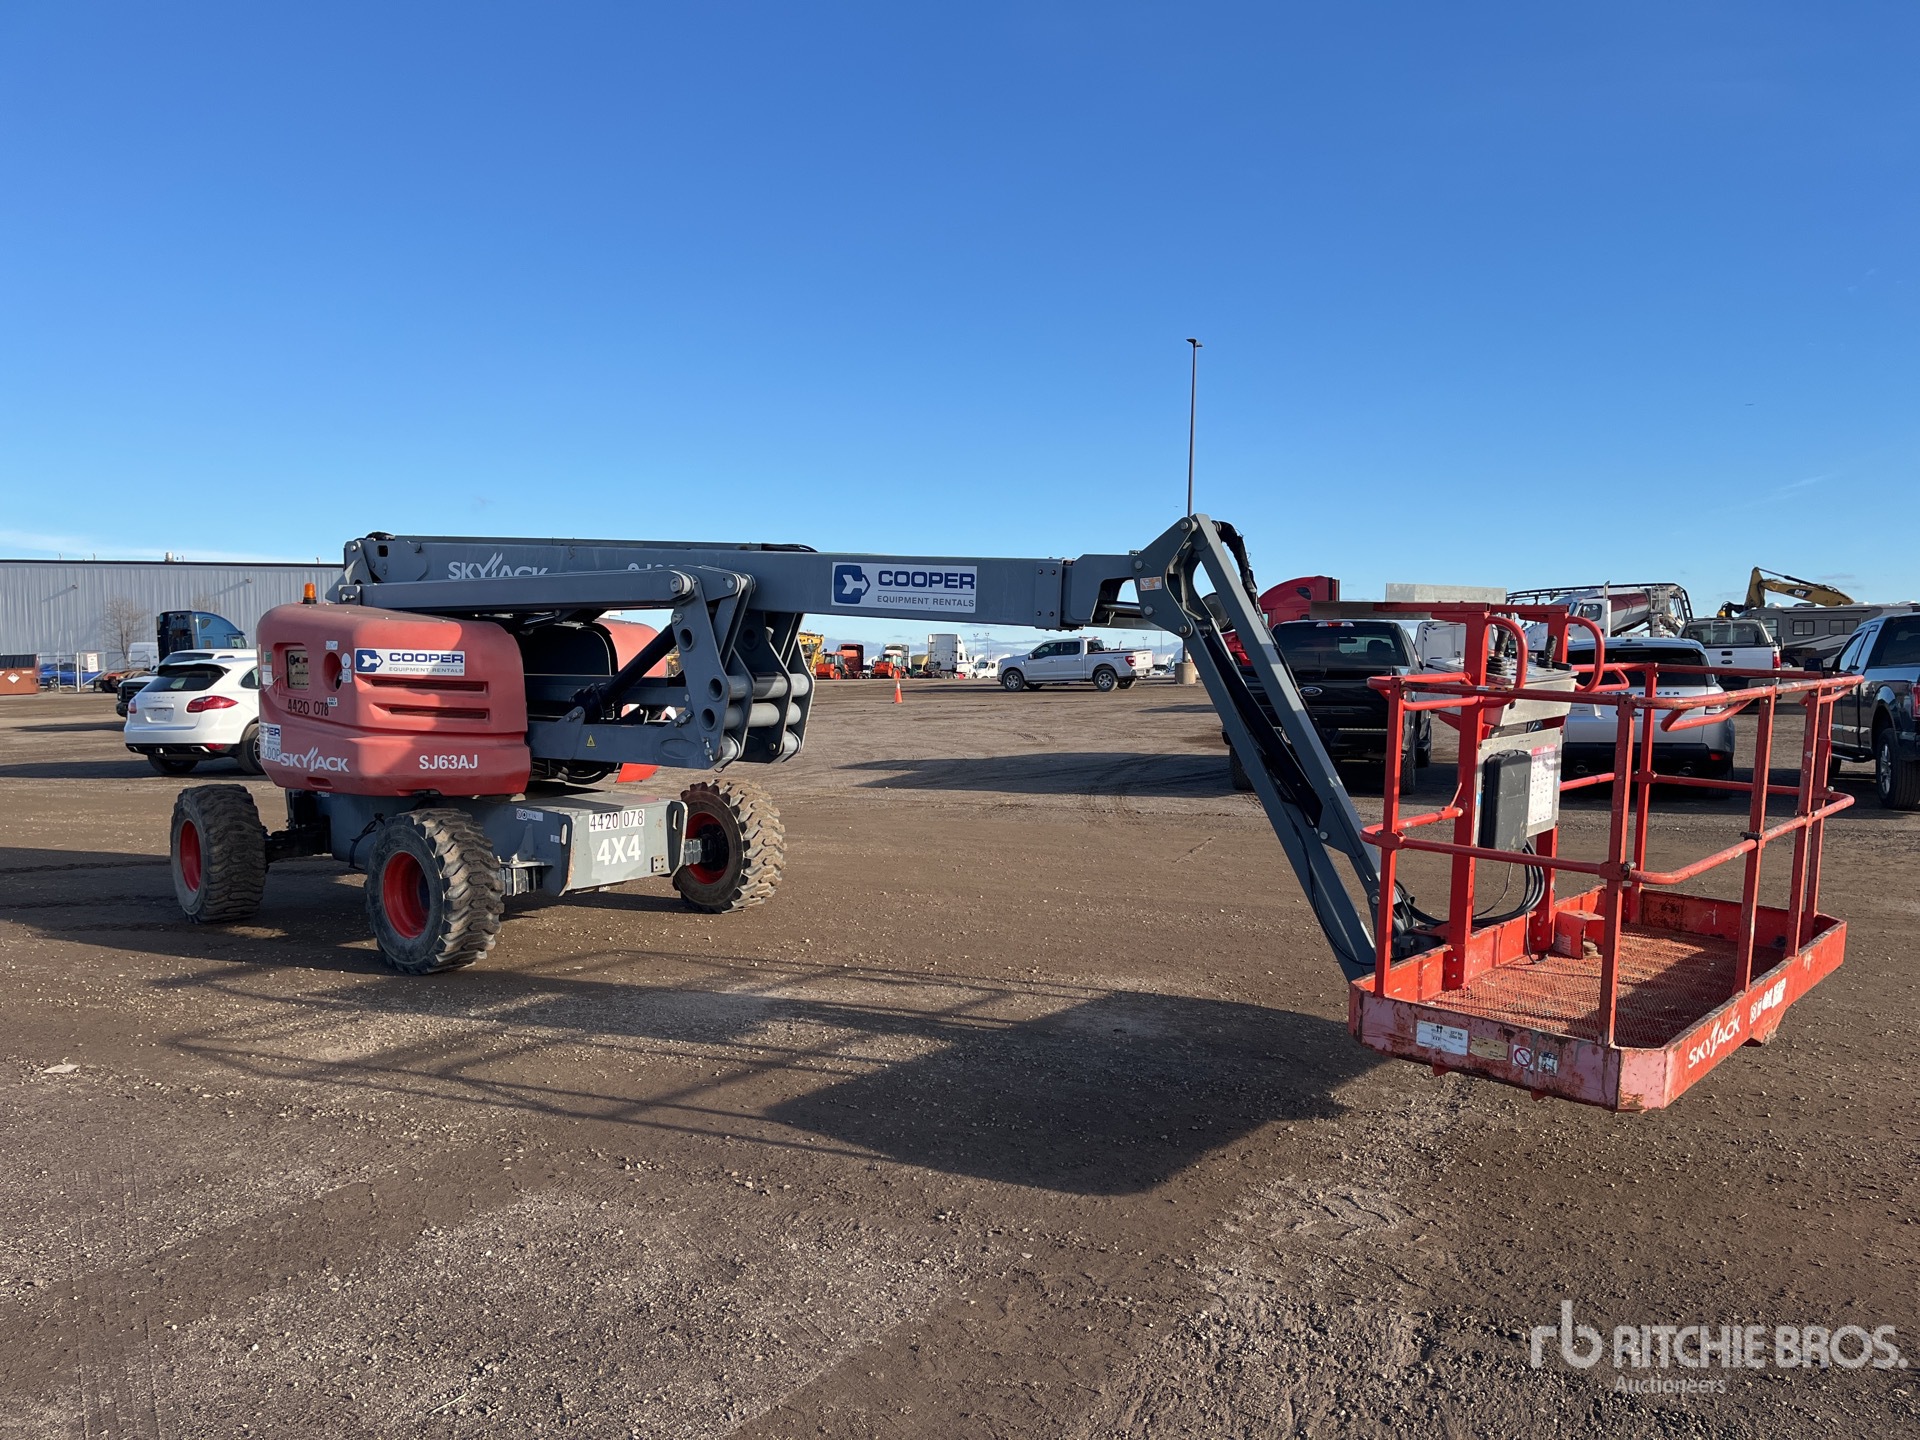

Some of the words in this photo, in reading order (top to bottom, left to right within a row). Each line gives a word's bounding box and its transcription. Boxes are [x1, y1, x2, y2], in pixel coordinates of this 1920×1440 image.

[878, 570, 975, 590] COOPER
[877, 595, 930, 605] EQUIPMENT
[932, 598, 975, 607] RENTALS
[389, 652, 464, 664] COOPER
[287, 698, 310, 715] 4420
[313, 700, 329, 716] 078
[280, 746, 350, 773] SKYJACK
[418, 754, 478, 770] SJ63AJ
[590, 812, 618, 830] 4420
[623, 810, 644, 827] 078
[596, 834, 641, 866] 4X4
[1687, 1014, 1741, 1069] SKYJACK
